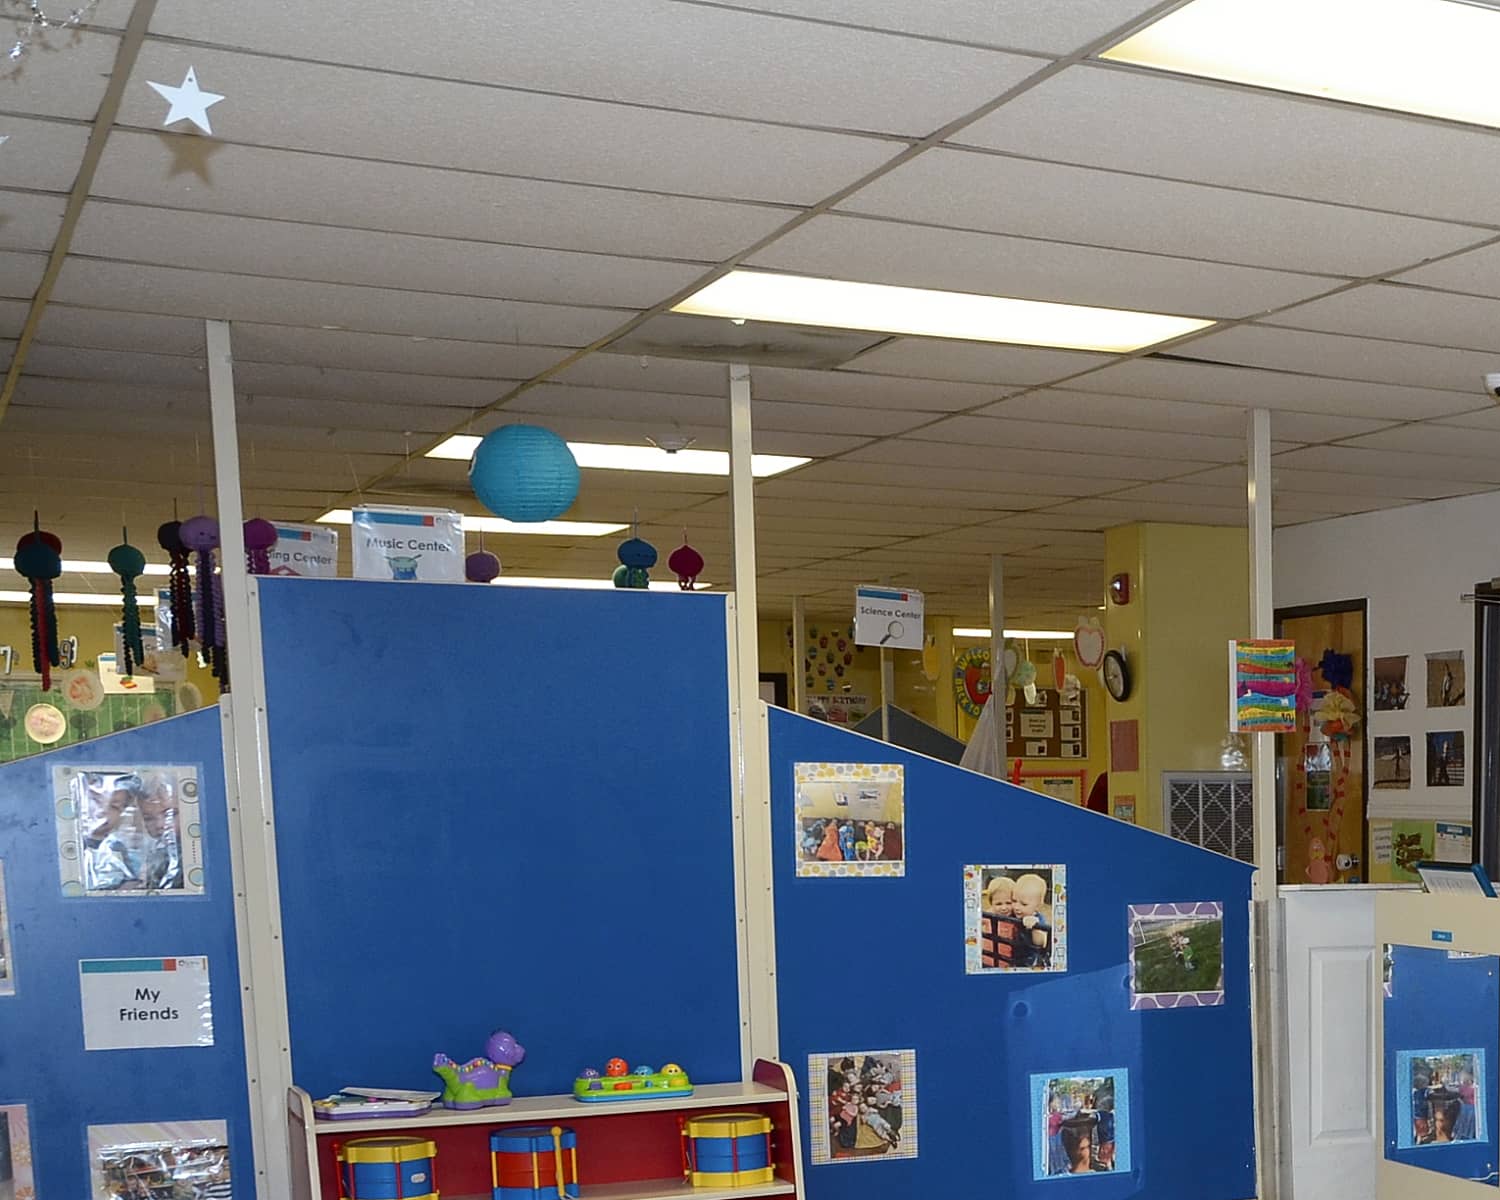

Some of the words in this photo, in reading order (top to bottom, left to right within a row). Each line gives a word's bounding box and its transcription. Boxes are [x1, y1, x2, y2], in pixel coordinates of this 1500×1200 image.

[366, 537, 403, 551] Music
[407, 538, 450, 553] Center
[293, 552, 333, 565] Center
[860, 605, 893, 618] Science
[894, 608, 922, 620] Center
[135, 988, 161, 1003] My
[119, 1007, 179, 1022] Friends
